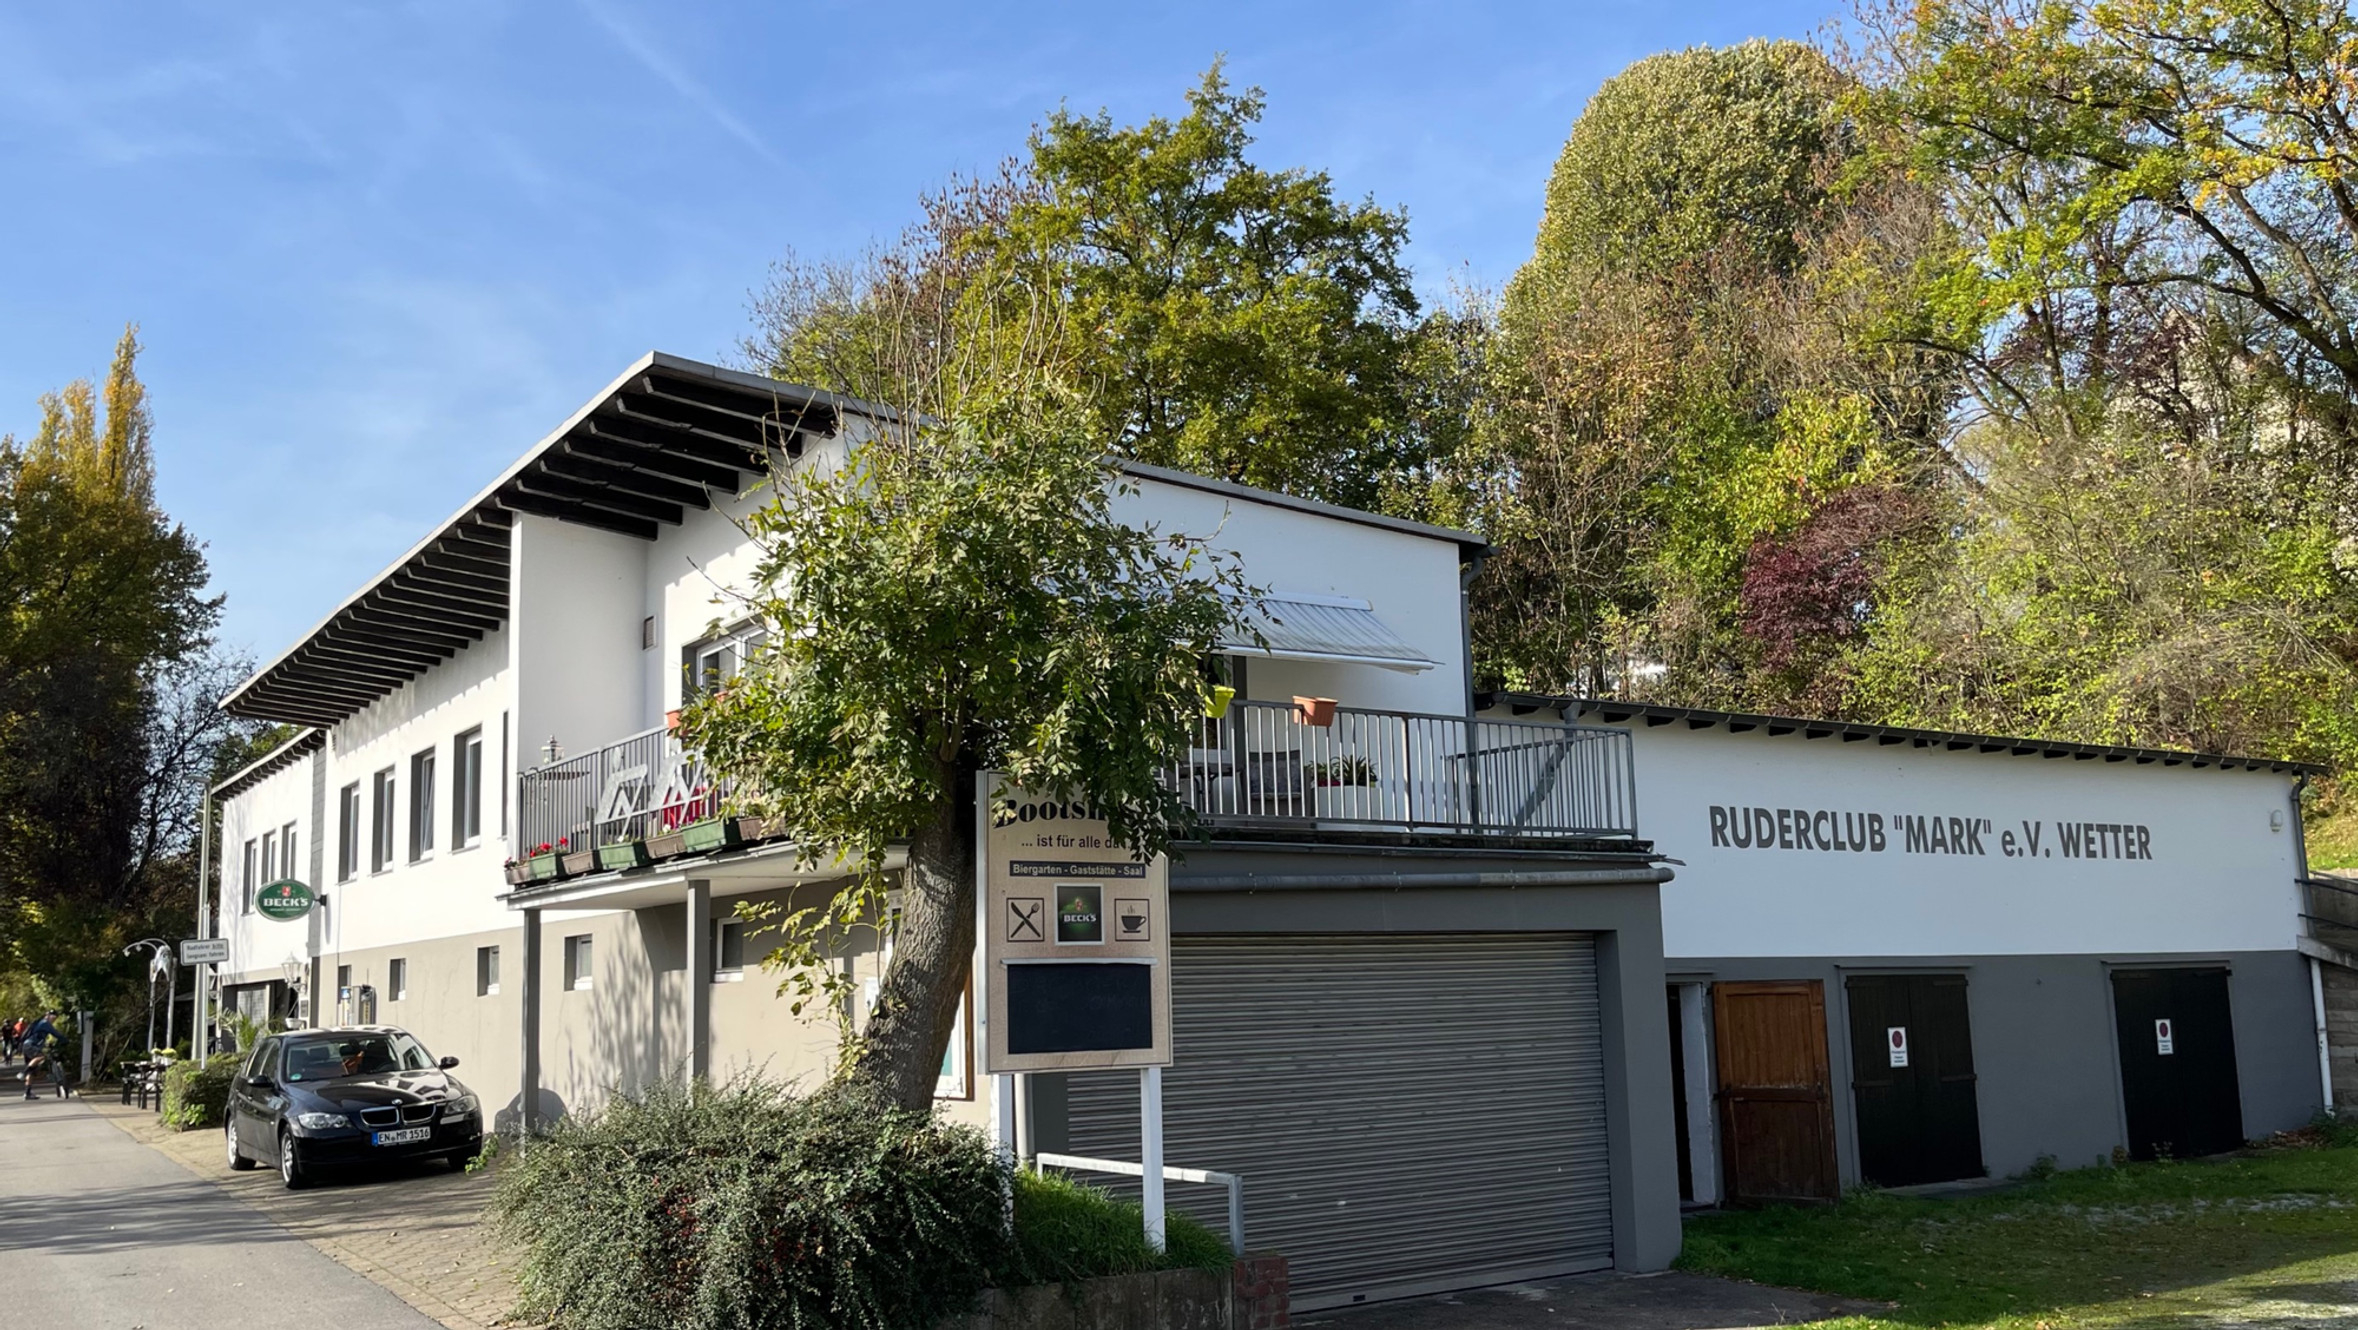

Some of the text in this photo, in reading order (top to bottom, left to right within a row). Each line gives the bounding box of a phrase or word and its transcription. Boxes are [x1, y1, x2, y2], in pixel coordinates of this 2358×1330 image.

[1709, 806, 2153, 860] RUDERCLUB "MARK" e.V. WETTER
[1037, 834, 1053, 847] ist
[1057, 834, 1075, 848] für
[1078, 836, 1101, 848] alle
[1013, 863, 1062, 876] Biergarten
[1070, 865, 1116, 875] Gaststätte
[1123, 866, 1143, 876] Saal
[263, 897, 309, 907] BECK'S
[1063, 912, 1097, 922] BECK'S
[409, 1128, 429, 1139] 1516
